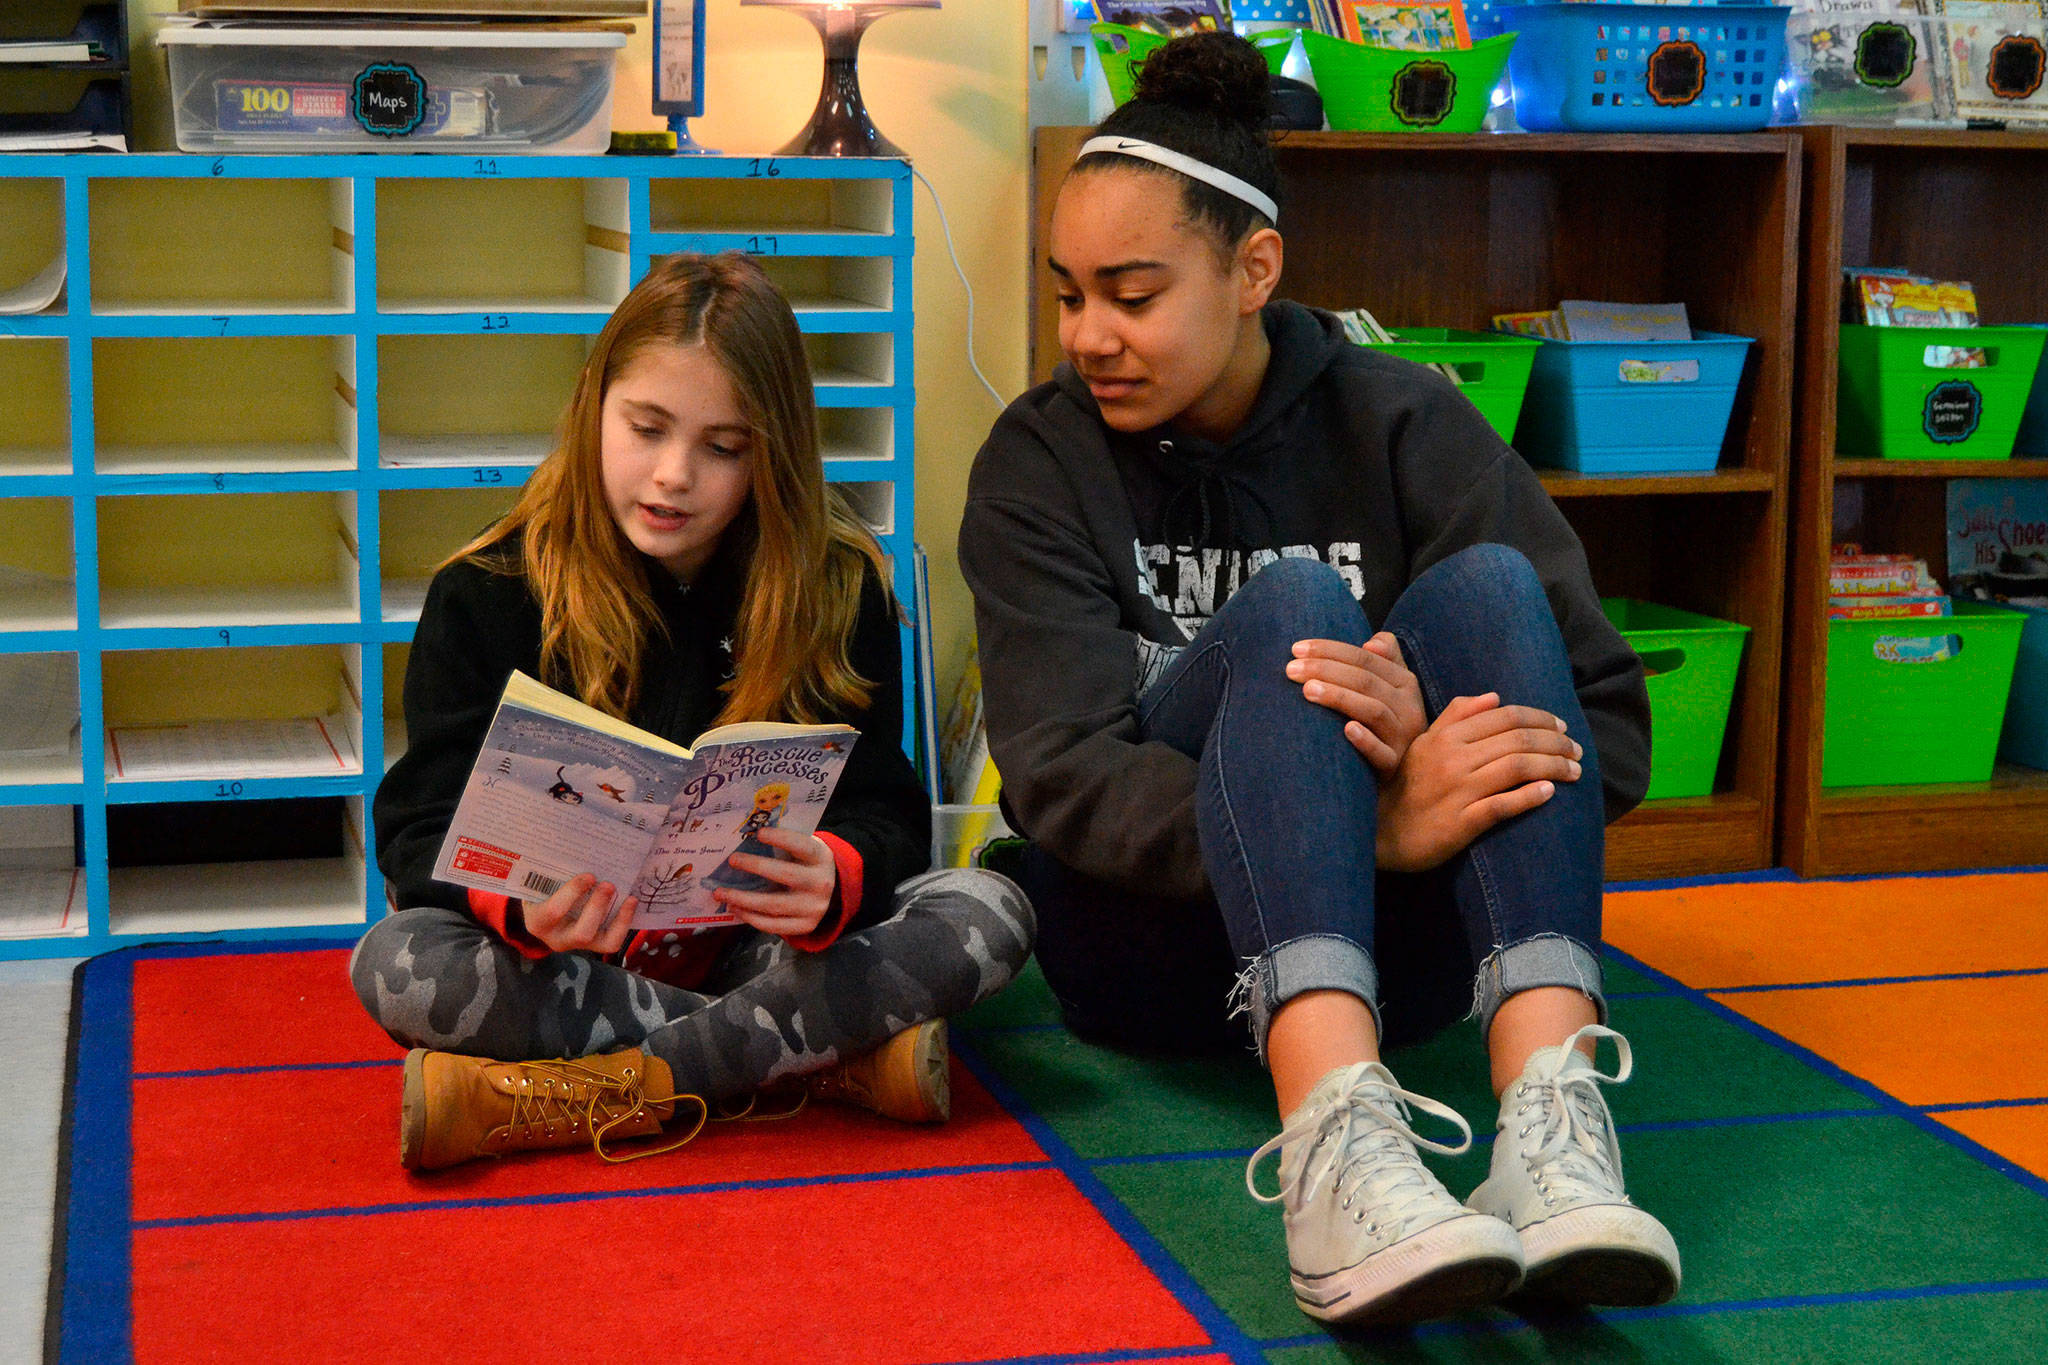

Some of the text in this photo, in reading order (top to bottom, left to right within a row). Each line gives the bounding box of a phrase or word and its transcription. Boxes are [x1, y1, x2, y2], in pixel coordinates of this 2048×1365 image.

[240, 88, 290, 112] 100
[369, 91, 408, 114] Maps
[210, 157, 225, 176] 6
[474, 158, 501, 175] 11
[746, 158, 780, 177] 16
[746, 237, 778, 254] 17
[212, 318, 231, 336] 7
[482, 315, 510, 329] 12
[212, 472, 226, 491] 8
[473, 469, 502, 483] 13
[1998, 518, 2048, 555] Shoe
[219, 629, 231, 647] 9
[730, 745, 823, 767] Rescue
[215, 782, 243, 797] 10
[683, 760, 829, 810] Princesses
